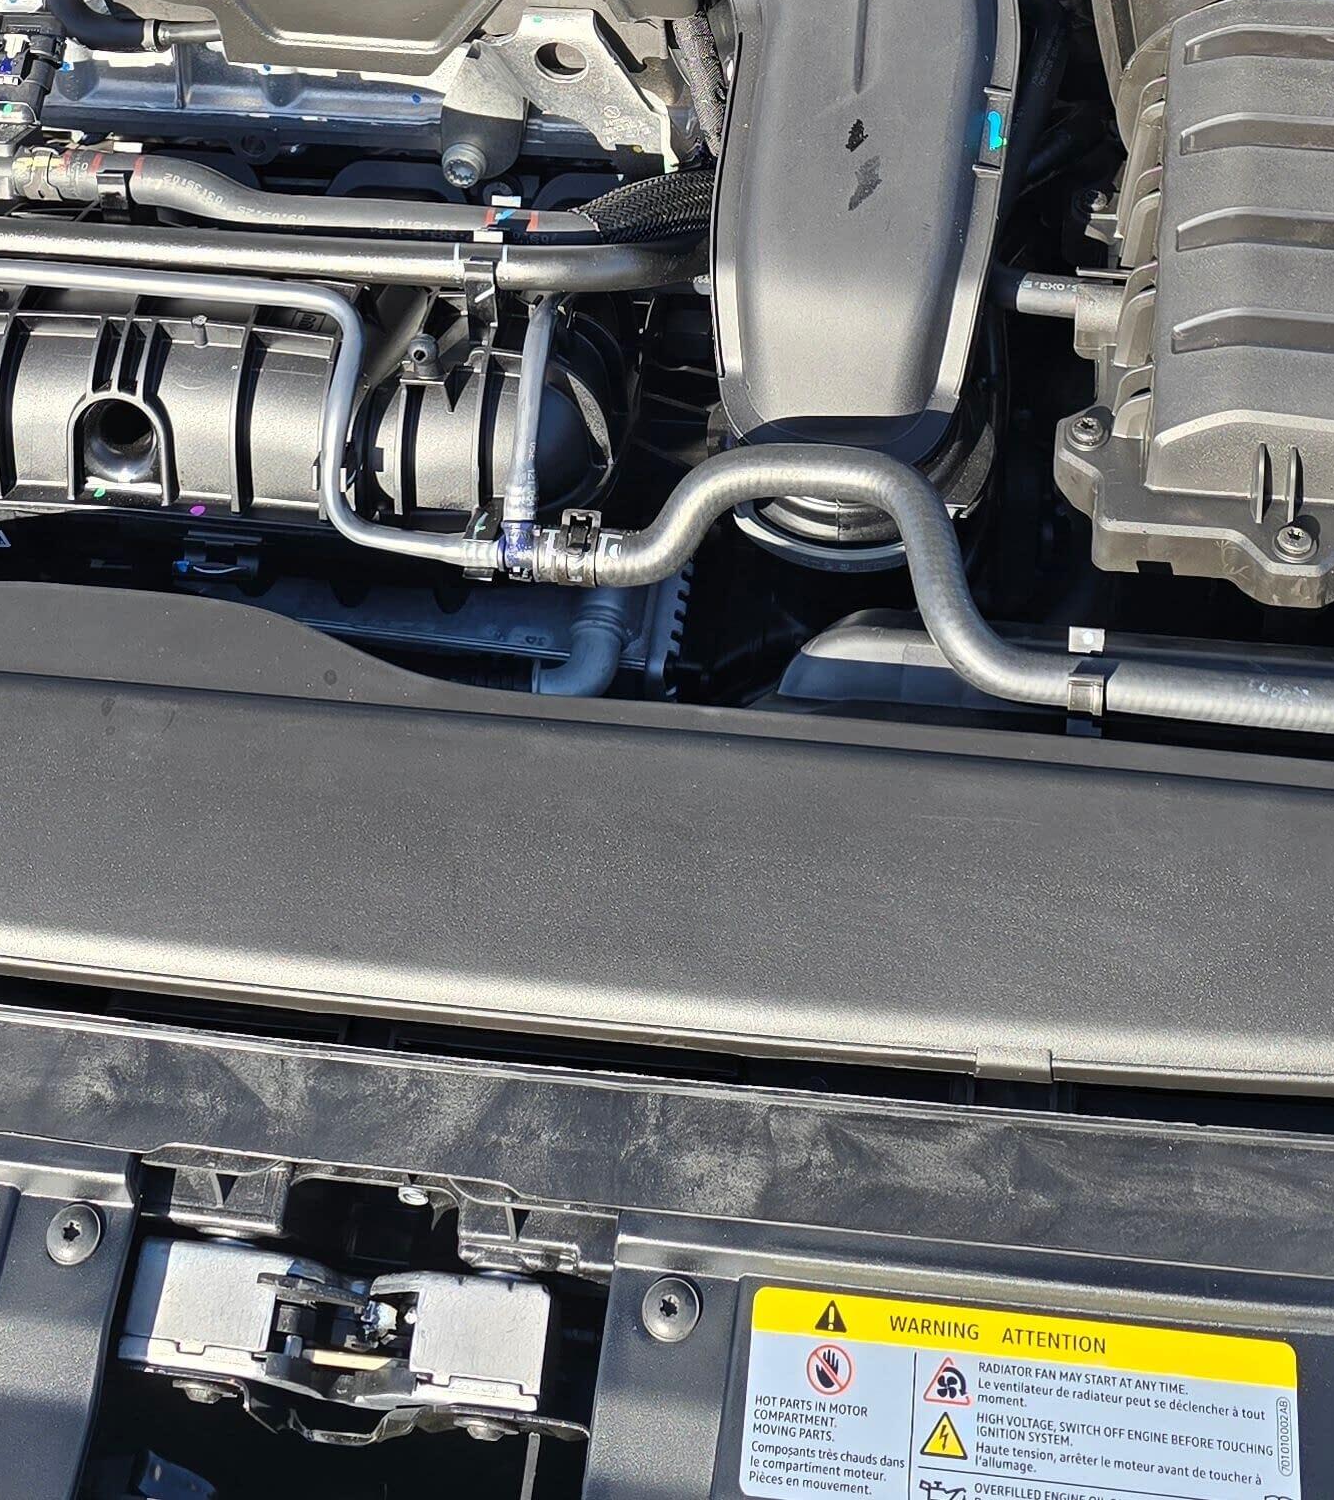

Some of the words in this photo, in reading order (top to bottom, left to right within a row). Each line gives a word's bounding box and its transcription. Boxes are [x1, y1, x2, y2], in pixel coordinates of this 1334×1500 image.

[889, 1315, 979, 1340] WARNING
[1001, 1327, 1107, 1354] ATTENTION
[979, 1362, 1033, 1378] RADIATOR
[1035, 1368, 1057, 1380] FAN
[1059, 1371, 1083, 1383] MAY
[1085, 1373, 1118, 1388] START
[1119, 1378, 1133, 1389] AT
[1135, 1379, 1160, 1392] ANY
[1159, 1382, 1189, 1396] TIME.
[755, 1394, 778, 1406] HOT
[779, 1397, 813, 1412] PARTS
[815, 1402, 826, 1413] IN
[829, 1402, 868, 1418] MOTOR
[977, 1394, 1027, 1408] moment.
[978, 1378, 992, 1390] Le
[993, 1380, 1055, 1397] ventilateur
[1055, 1385, 1070, 1398] de
[1072, 1387, 1123, 1404] radiateur
[1125, 1396, 1151, 1408] peut
[1153, 1399, 1167, 1410] se
[1169, 1400, 1230, 1417] déclencher
[1231, 1406, 1239, 1418] à
[1241, 1407, 1266, 1421] tout
[753, 1408, 837, 1428] COMPARTMENT.
[753, 1422, 797, 1438] MOVING
[799, 1429, 835, 1442] PARTS.
[977, 1412, 1005, 1426] HIGH
[1007, 1414, 1057, 1433] VOLTAGE,
[1059, 1420, 1101, 1436] SWITCH
[1103, 1426, 1125, 1440] OFF
[1127, 1428, 1169, 1445] ENGINE
[1171, 1434, 1215, 1450] BEFORE
[1216, 1439, 1274, 1457] TOUCHING
[977, 1426, 1025, 1442] IGNITION
[1028, 1430, 1074, 1448] SYSTEM.
[751, 1440, 816, 1458] Composants
[818, 1447, 839, 1461] très
[840, 1450, 877, 1466] chauds
[879, 1456, 905, 1468] dans
[975, 1442, 1010, 1456] Haute
[1012, 1446, 1057, 1464] tension,
[1059, 1452, 1099, 1468] arrêter
[1101, 1456, 1111, 1468] le
[1113, 1459, 1155, 1474] moteur
[1157, 1464, 1189, 1478] avant
[1192, 1466, 1206, 1480] de
[1209, 1468, 1253, 1486] toucher
[1255, 1474, 1263, 1486] à
[975, 1456, 1037, 1475] l'allumage.
[749, 1455, 760, 1467] le
[762, 1458, 841, 1477] compartiment
[843, 1468, 887, 1482] moteur.
[749, 1470, 784, 1485] Pièces
[785, 1477, 800, 1488] en
[802, 1478, 873, 1496] mouvement.
[973, 1482, 1041, 1500] OVERFILLED
